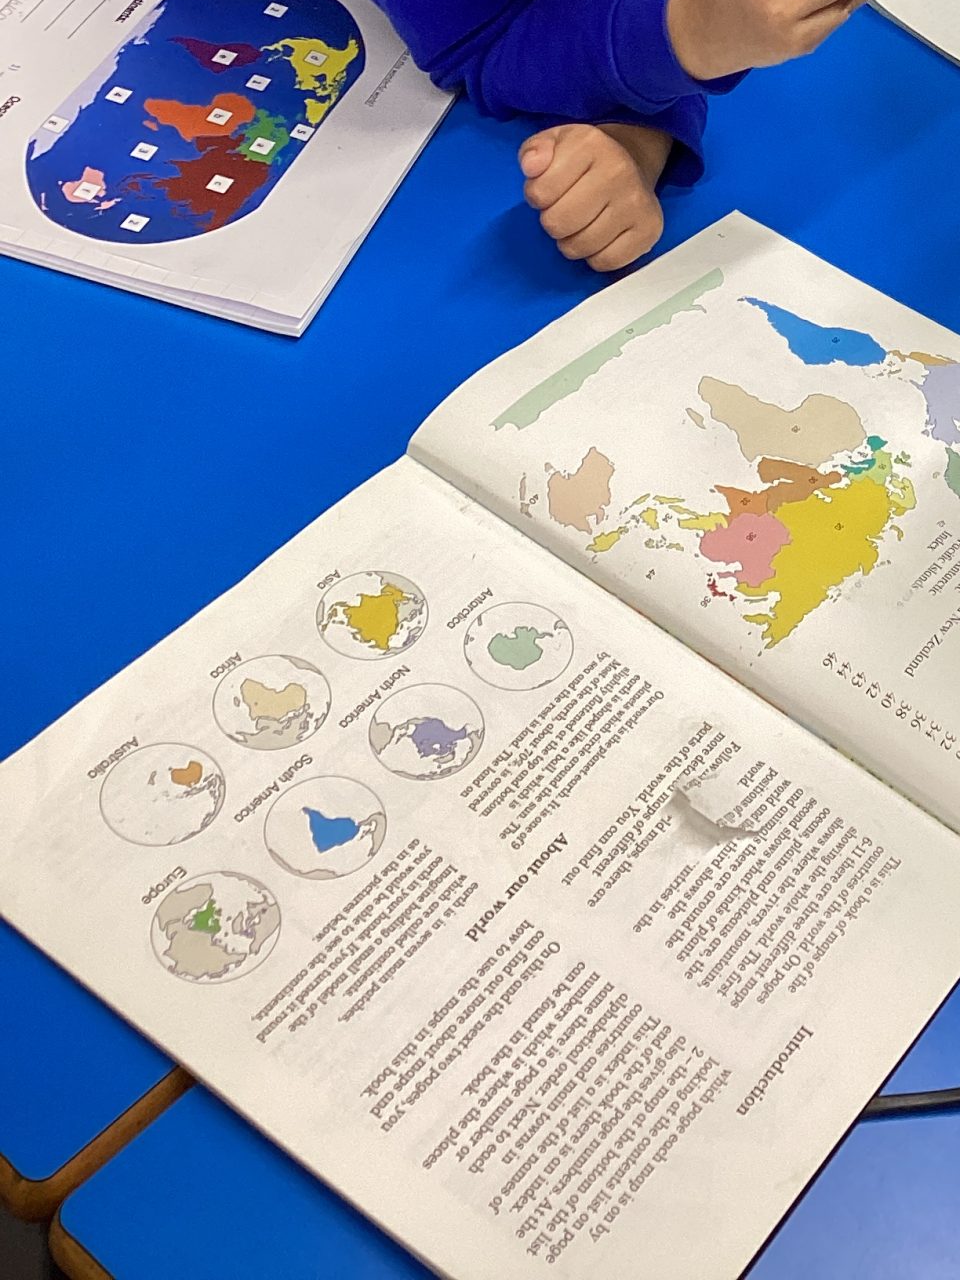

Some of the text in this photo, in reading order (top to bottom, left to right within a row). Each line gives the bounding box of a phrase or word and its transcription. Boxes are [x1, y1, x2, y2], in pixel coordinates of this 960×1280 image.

[316, 568, 341, 589] Asia
[911, 561, 942, 588] Islands
[446, 587, 493, 629] Antarctica
[822, 530, 952, 670] Index 46
[209, 651, 241, 678] Africa
[835, 661, 851, 679] 44
[903, 633, 943, 677] Zealand
[338, 664, 410, 728] North America
[850, 671, 866, 687] 43
[865, 681, 880, 698] 42
[880, 692, 895, 708] 40
[895, 700, 911, 719] 38
[910, 710, 926, 731] 36
[924, 720, 941, 741] 34
[939, 730, 956, 750] 32
[86, 735, 138, 779] Australia
[233, 753, 313, 823] South America
[140, 865, 187, 904] Europe
[464, 831, 568, 942] About our world
[787, 855, 901, 993] This is a book of maps of the
[379, 940, 560, 1132] On this and the next two pages, you
[735, 1024, 813, 1115] Introduction
[588, 1068, 732, 1243] which page each map is on by
